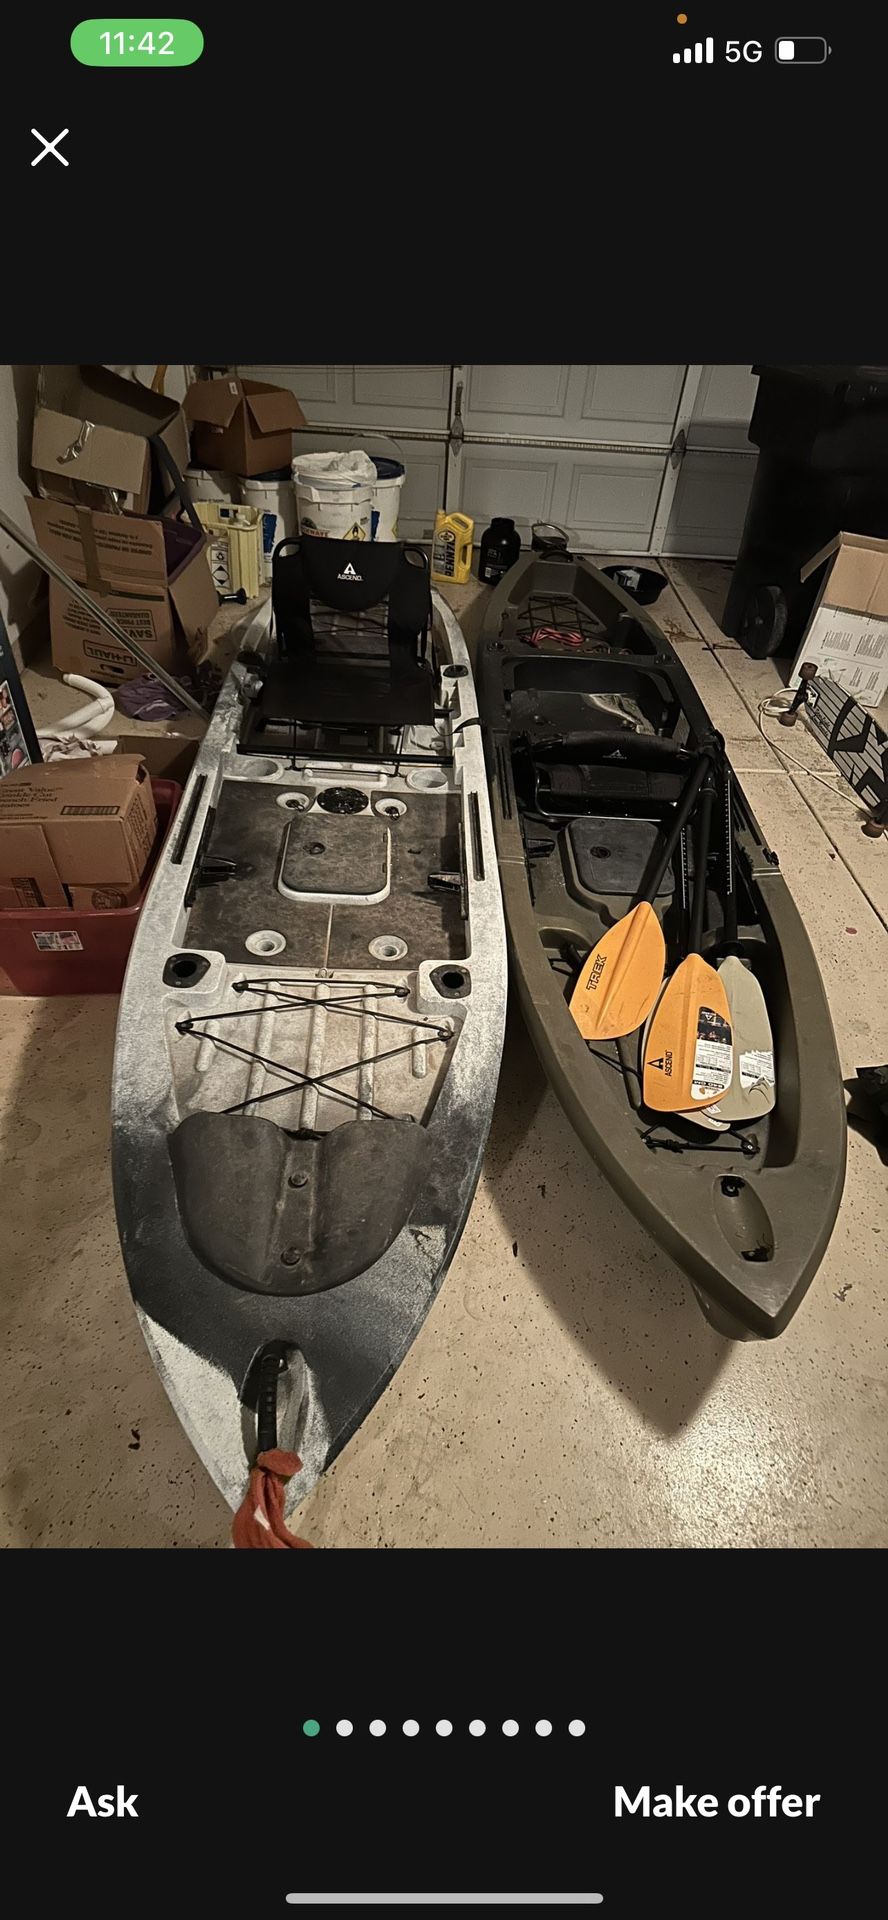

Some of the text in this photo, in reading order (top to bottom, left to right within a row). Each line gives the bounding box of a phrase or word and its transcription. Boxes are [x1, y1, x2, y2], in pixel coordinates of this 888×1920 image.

[123, 629, 153, 639] SAV
[586, 954, 607, 991] TREK
[664, 1051, 673, 1077] ASCEND
